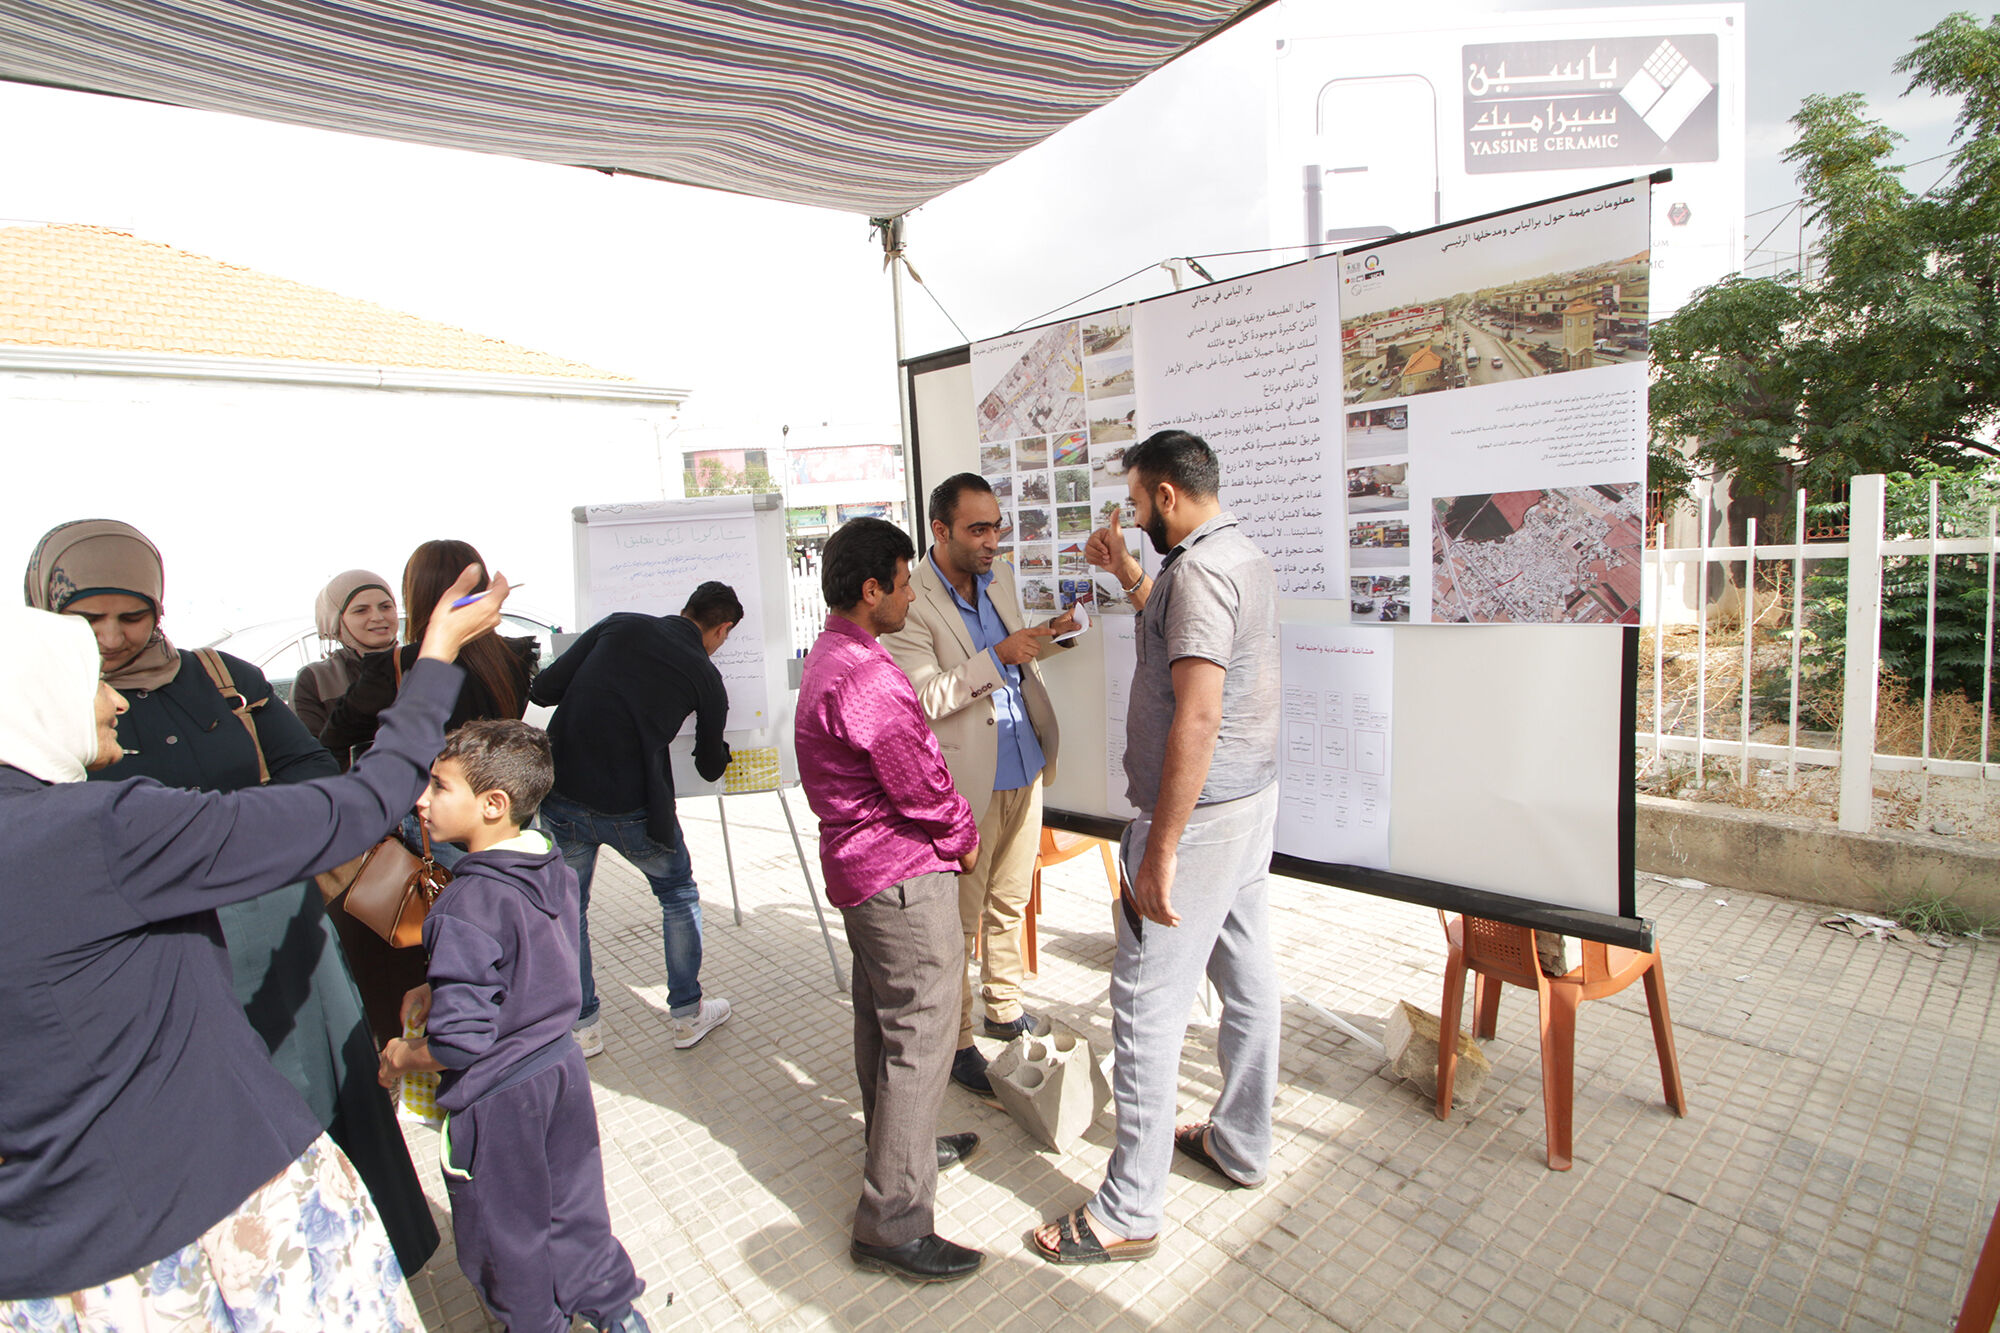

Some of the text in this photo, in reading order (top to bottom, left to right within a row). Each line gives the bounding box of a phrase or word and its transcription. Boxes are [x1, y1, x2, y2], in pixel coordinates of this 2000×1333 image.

[1468, 45, 1618, 96] ياسين
[1470, 101, 1617, 136] سيراميك
[1470, 134, 1619, 155] YASSINE CERAMIC
[1593, 196, 1635, 212] معلومات
[1568, 207, 1591, 217] مهمة
[1544, 214, 1565, 226] حول
[1474, 228, 1507, 242] ومدخلها
[1441, 234, 1470, 251] الرئيسي
[1212, 293, 1221, 304] في
[1267, 304, 1293, 317] الطبيعة
[1296, 301, 1317, 313] جمال
[1228, 338, 1236, 348] مع
[1206, 360, 1217, 370] على
[1262, 367, 1276, 378] دون
[1286, 400, 1294, 412] في
[1309, 416, 1320, 424] هنا
[1290, 456, 1313, 465] صعوبة
[1315, 452, 1320, 460] لا
[1310, 473, 1321, 482] من
[1271, 547, 1282, 557] على
